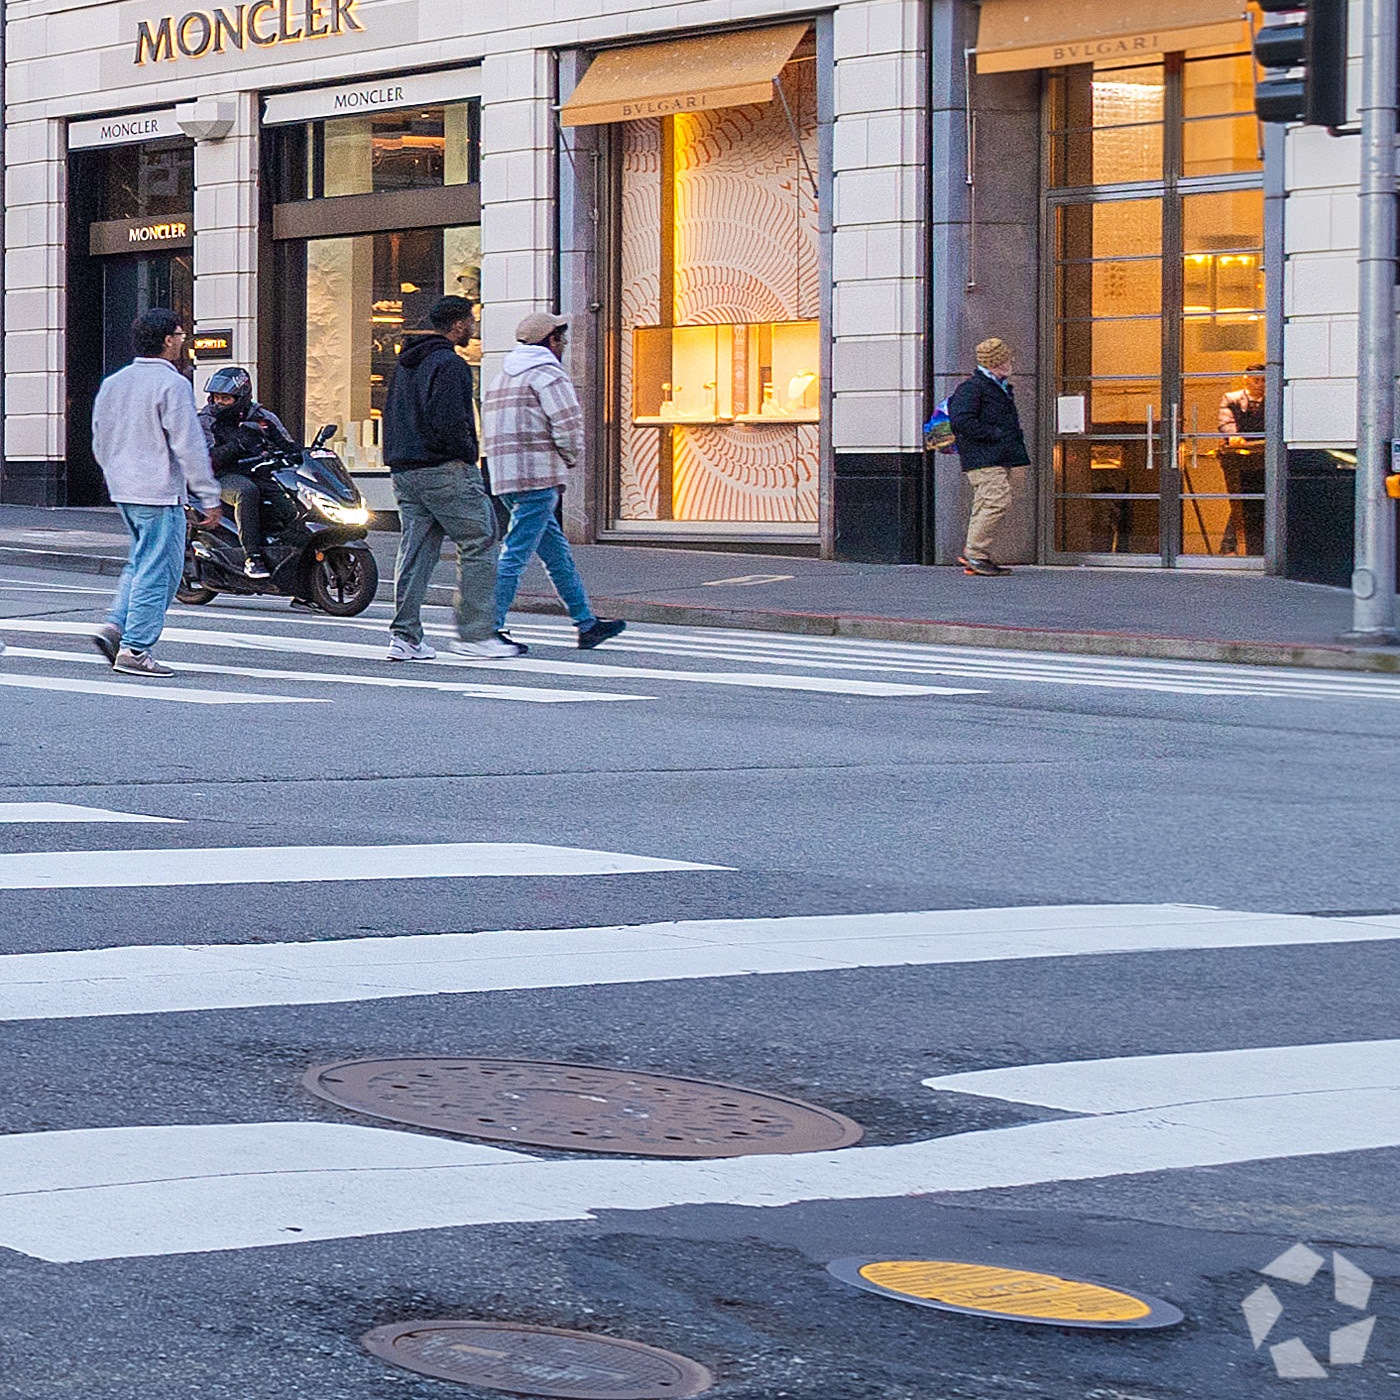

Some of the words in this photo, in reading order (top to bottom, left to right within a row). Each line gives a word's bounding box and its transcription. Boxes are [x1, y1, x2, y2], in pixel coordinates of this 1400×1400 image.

[1052, 34, 1159, 61] BVLGARI
[334, 86, 404, 109] MONCLER
[622, 95, 708, 117] BVLGARI
[100, 119, 159, 140] MONCLER
[128, 222, 187, 242] MONCLER
